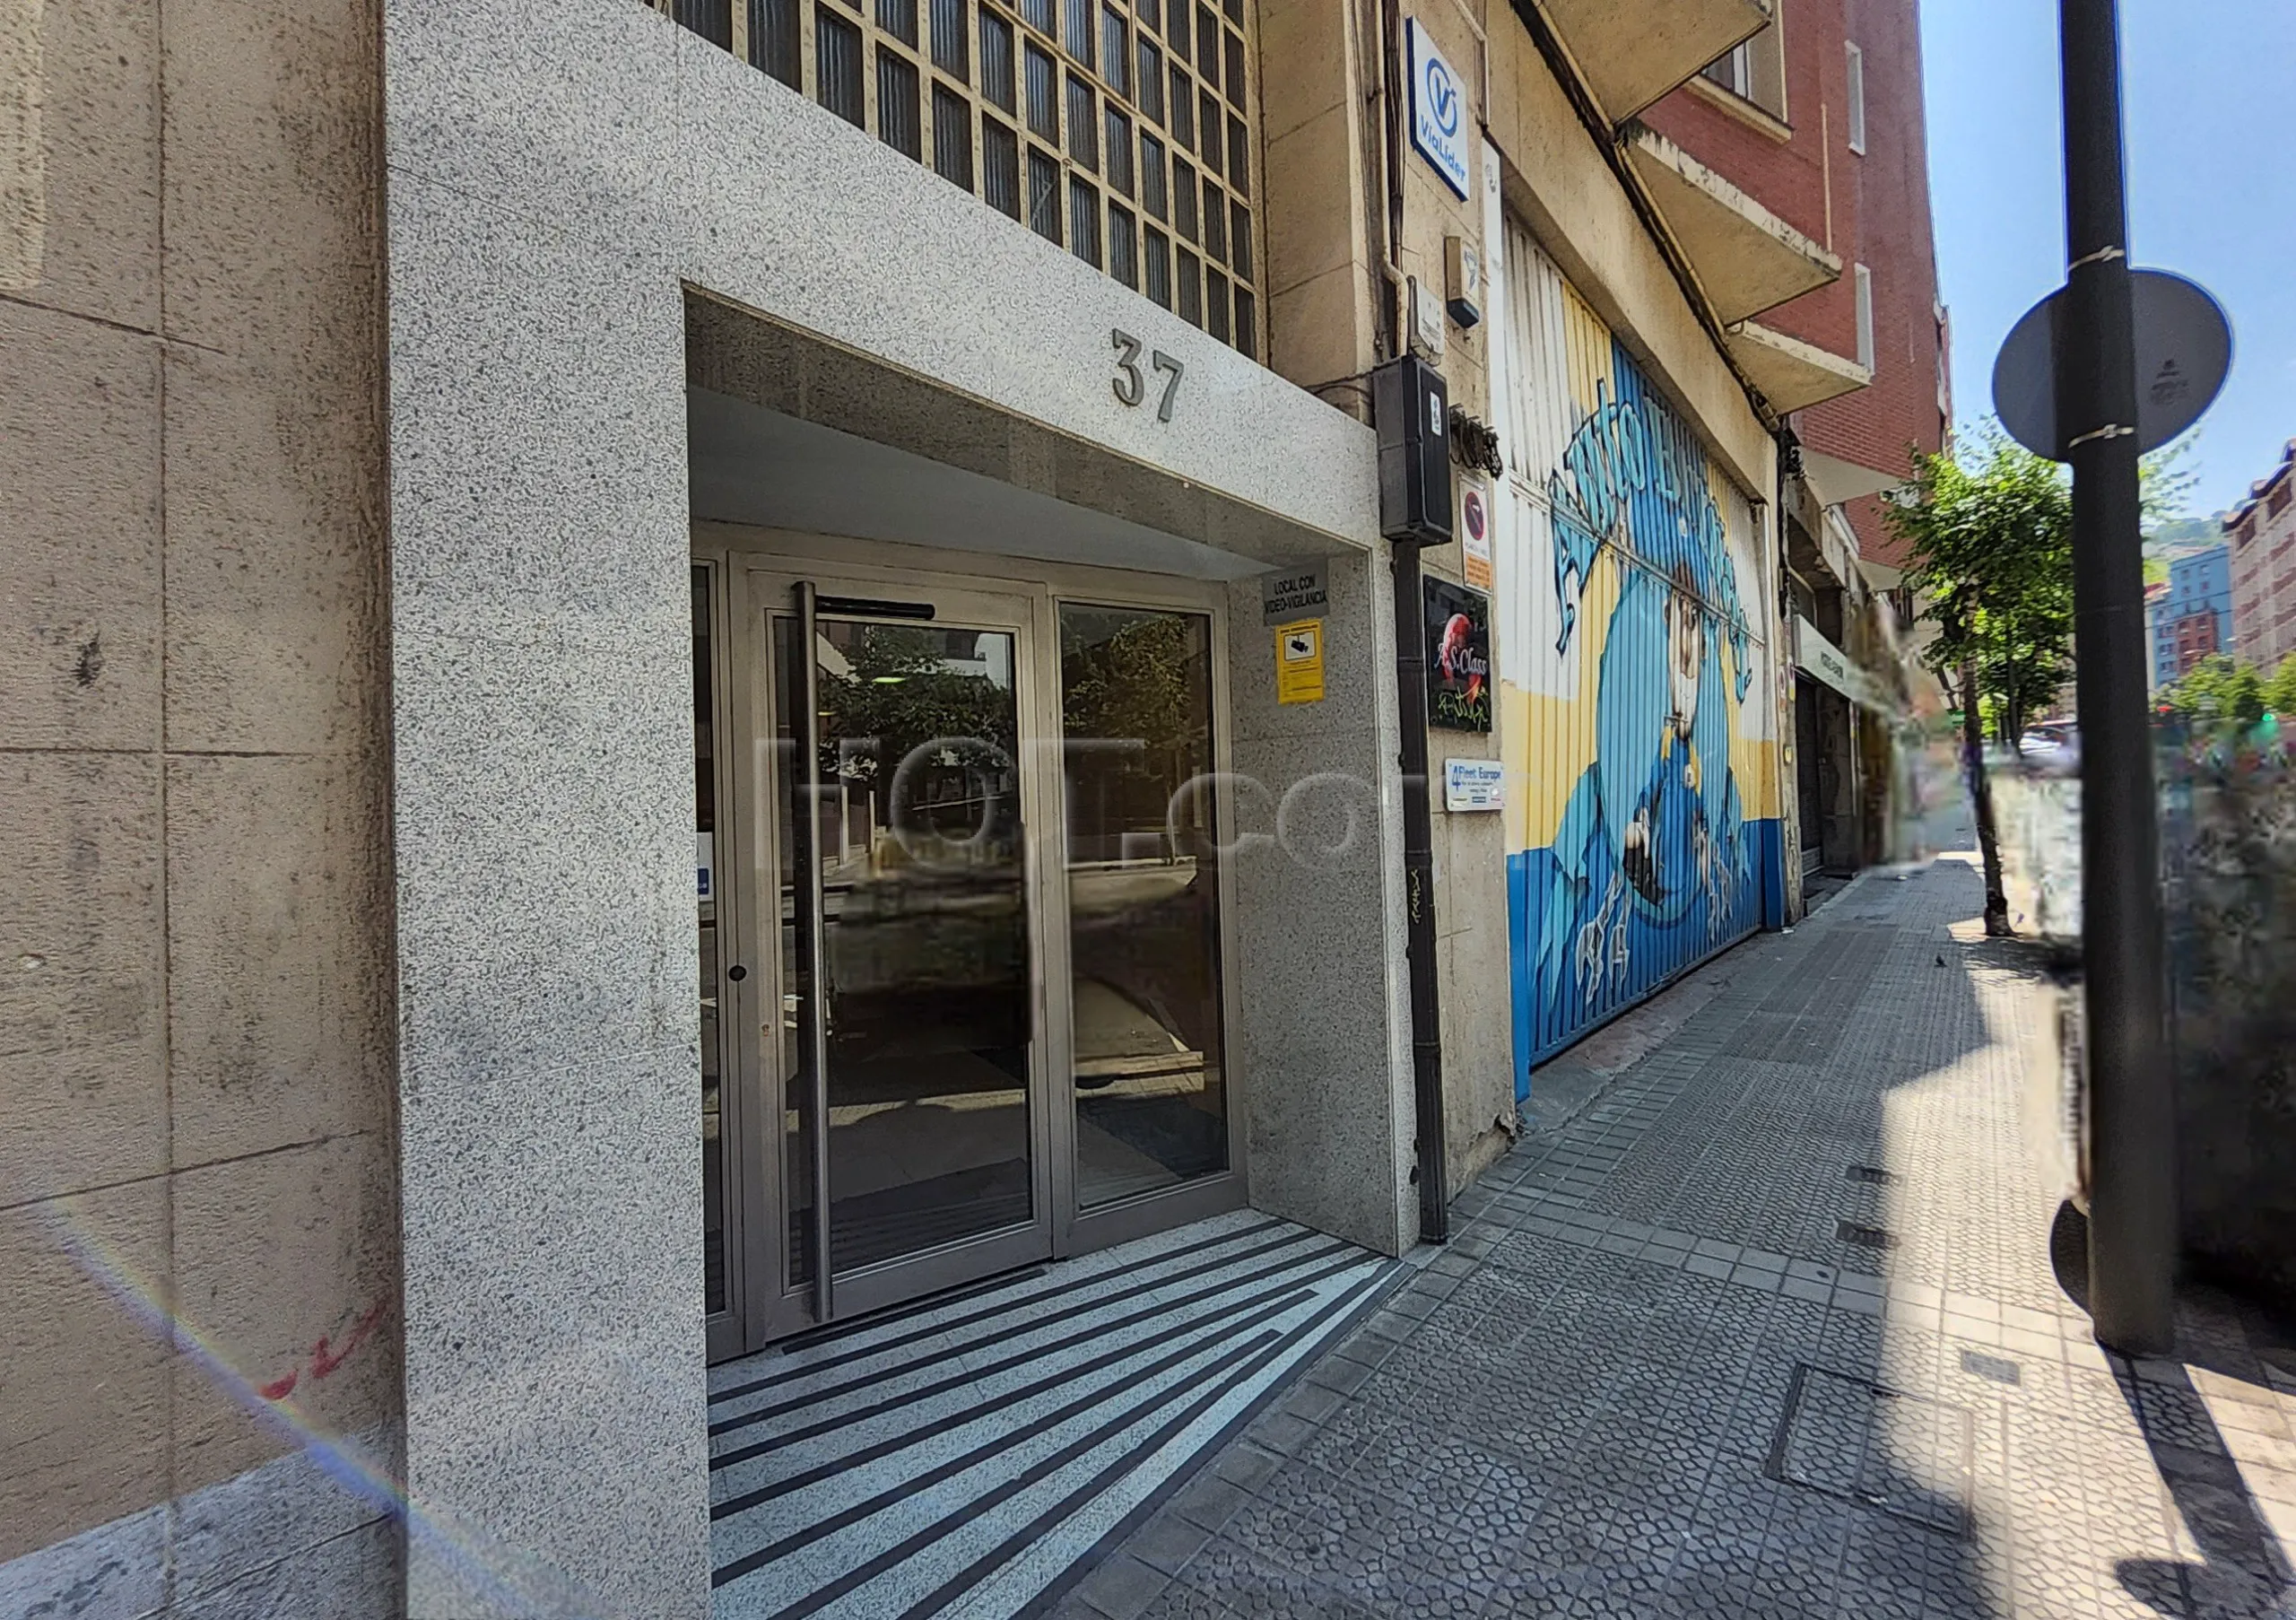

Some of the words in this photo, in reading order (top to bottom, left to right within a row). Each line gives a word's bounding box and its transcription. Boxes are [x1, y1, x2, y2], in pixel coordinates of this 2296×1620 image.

[1112, 327, 1185, 422] 37
[1274, 578, 1298, 596] LOCAL
[1300, 574, 1317, 590] CON
[1265, 589, 1328, 614] VIDEO-VIGILANCIA
